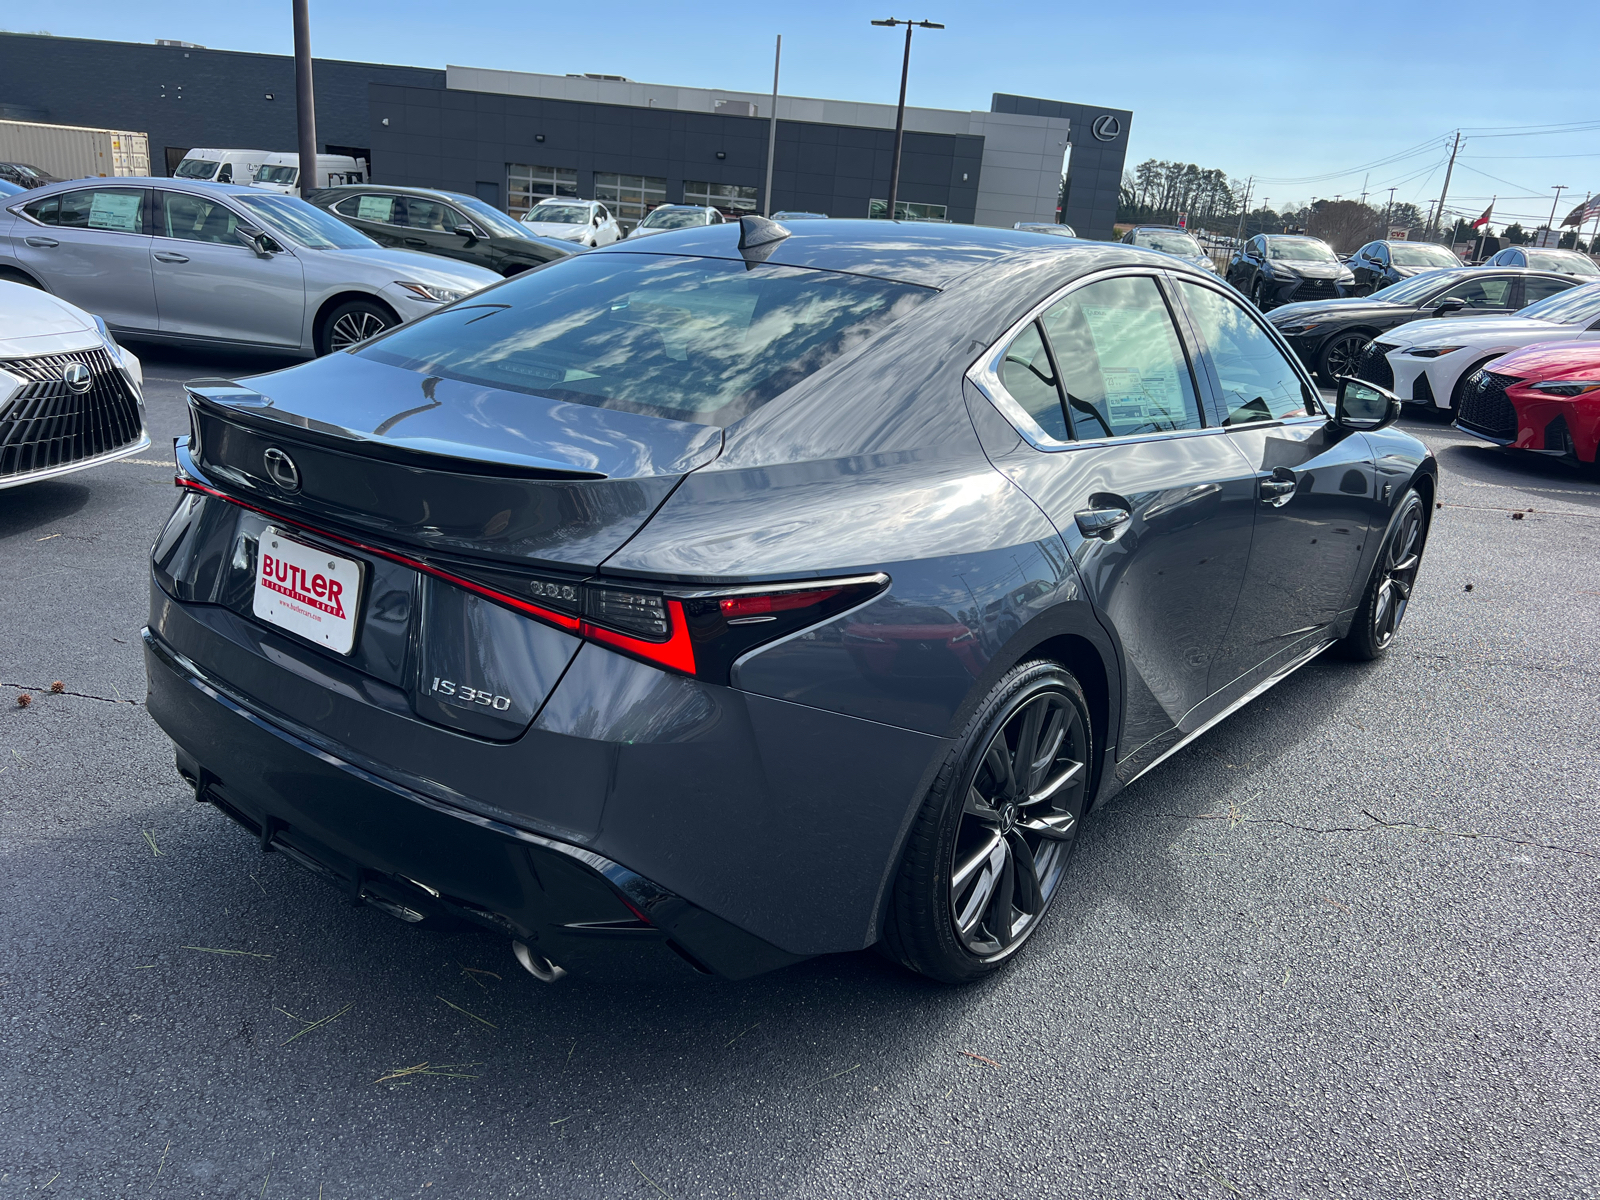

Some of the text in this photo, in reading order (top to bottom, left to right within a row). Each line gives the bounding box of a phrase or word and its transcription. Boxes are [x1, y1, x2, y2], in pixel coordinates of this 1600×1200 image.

[279, 599, 322, 622] www.butlercars.com
[316, 601, 344, 617] GROUP
[432, 677, 511, 711] IS 350
[974, 668, 1044, 743] BRIDGESTONE
